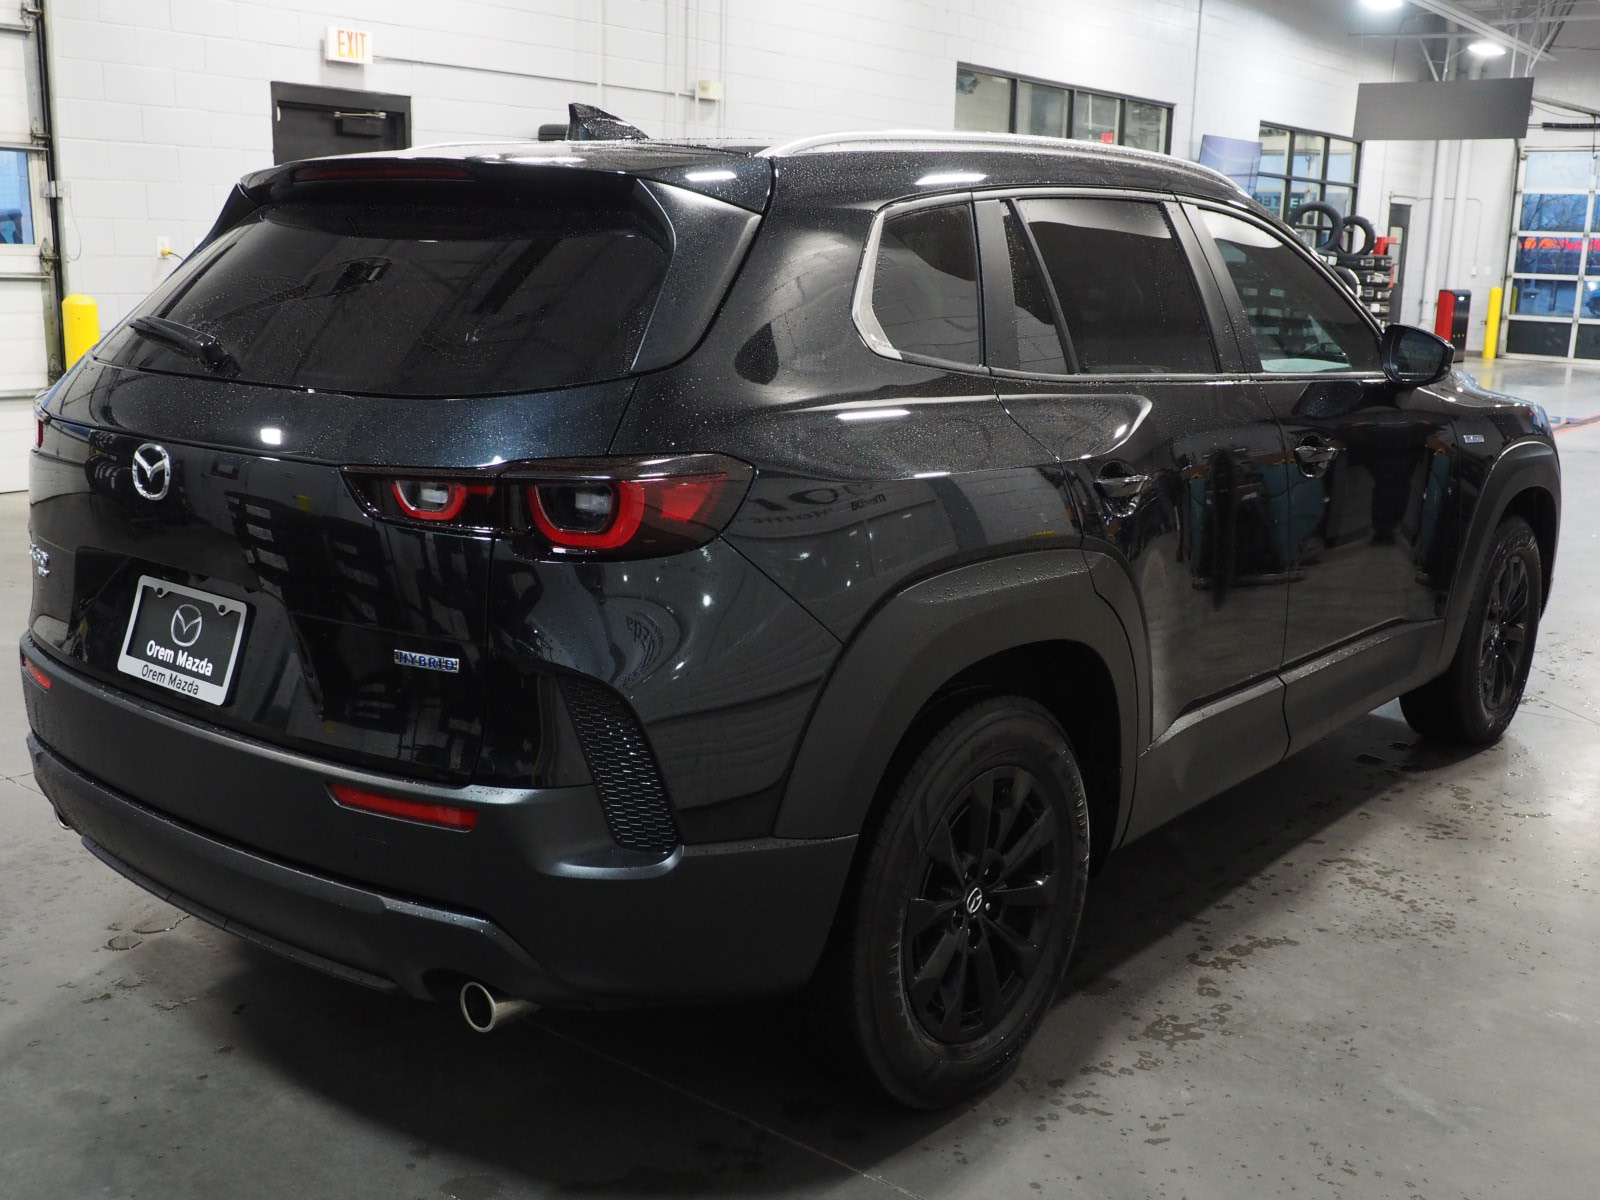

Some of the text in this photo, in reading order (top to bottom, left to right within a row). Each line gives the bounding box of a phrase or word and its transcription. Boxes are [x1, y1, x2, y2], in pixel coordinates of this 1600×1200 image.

[337, 30, 366, 59] EXIT
[146, 640, 213, 676] Orem Mazda
[398, 651, 455, 671] HYBRID
[141, 664, 199, 695] Orem Mazda
